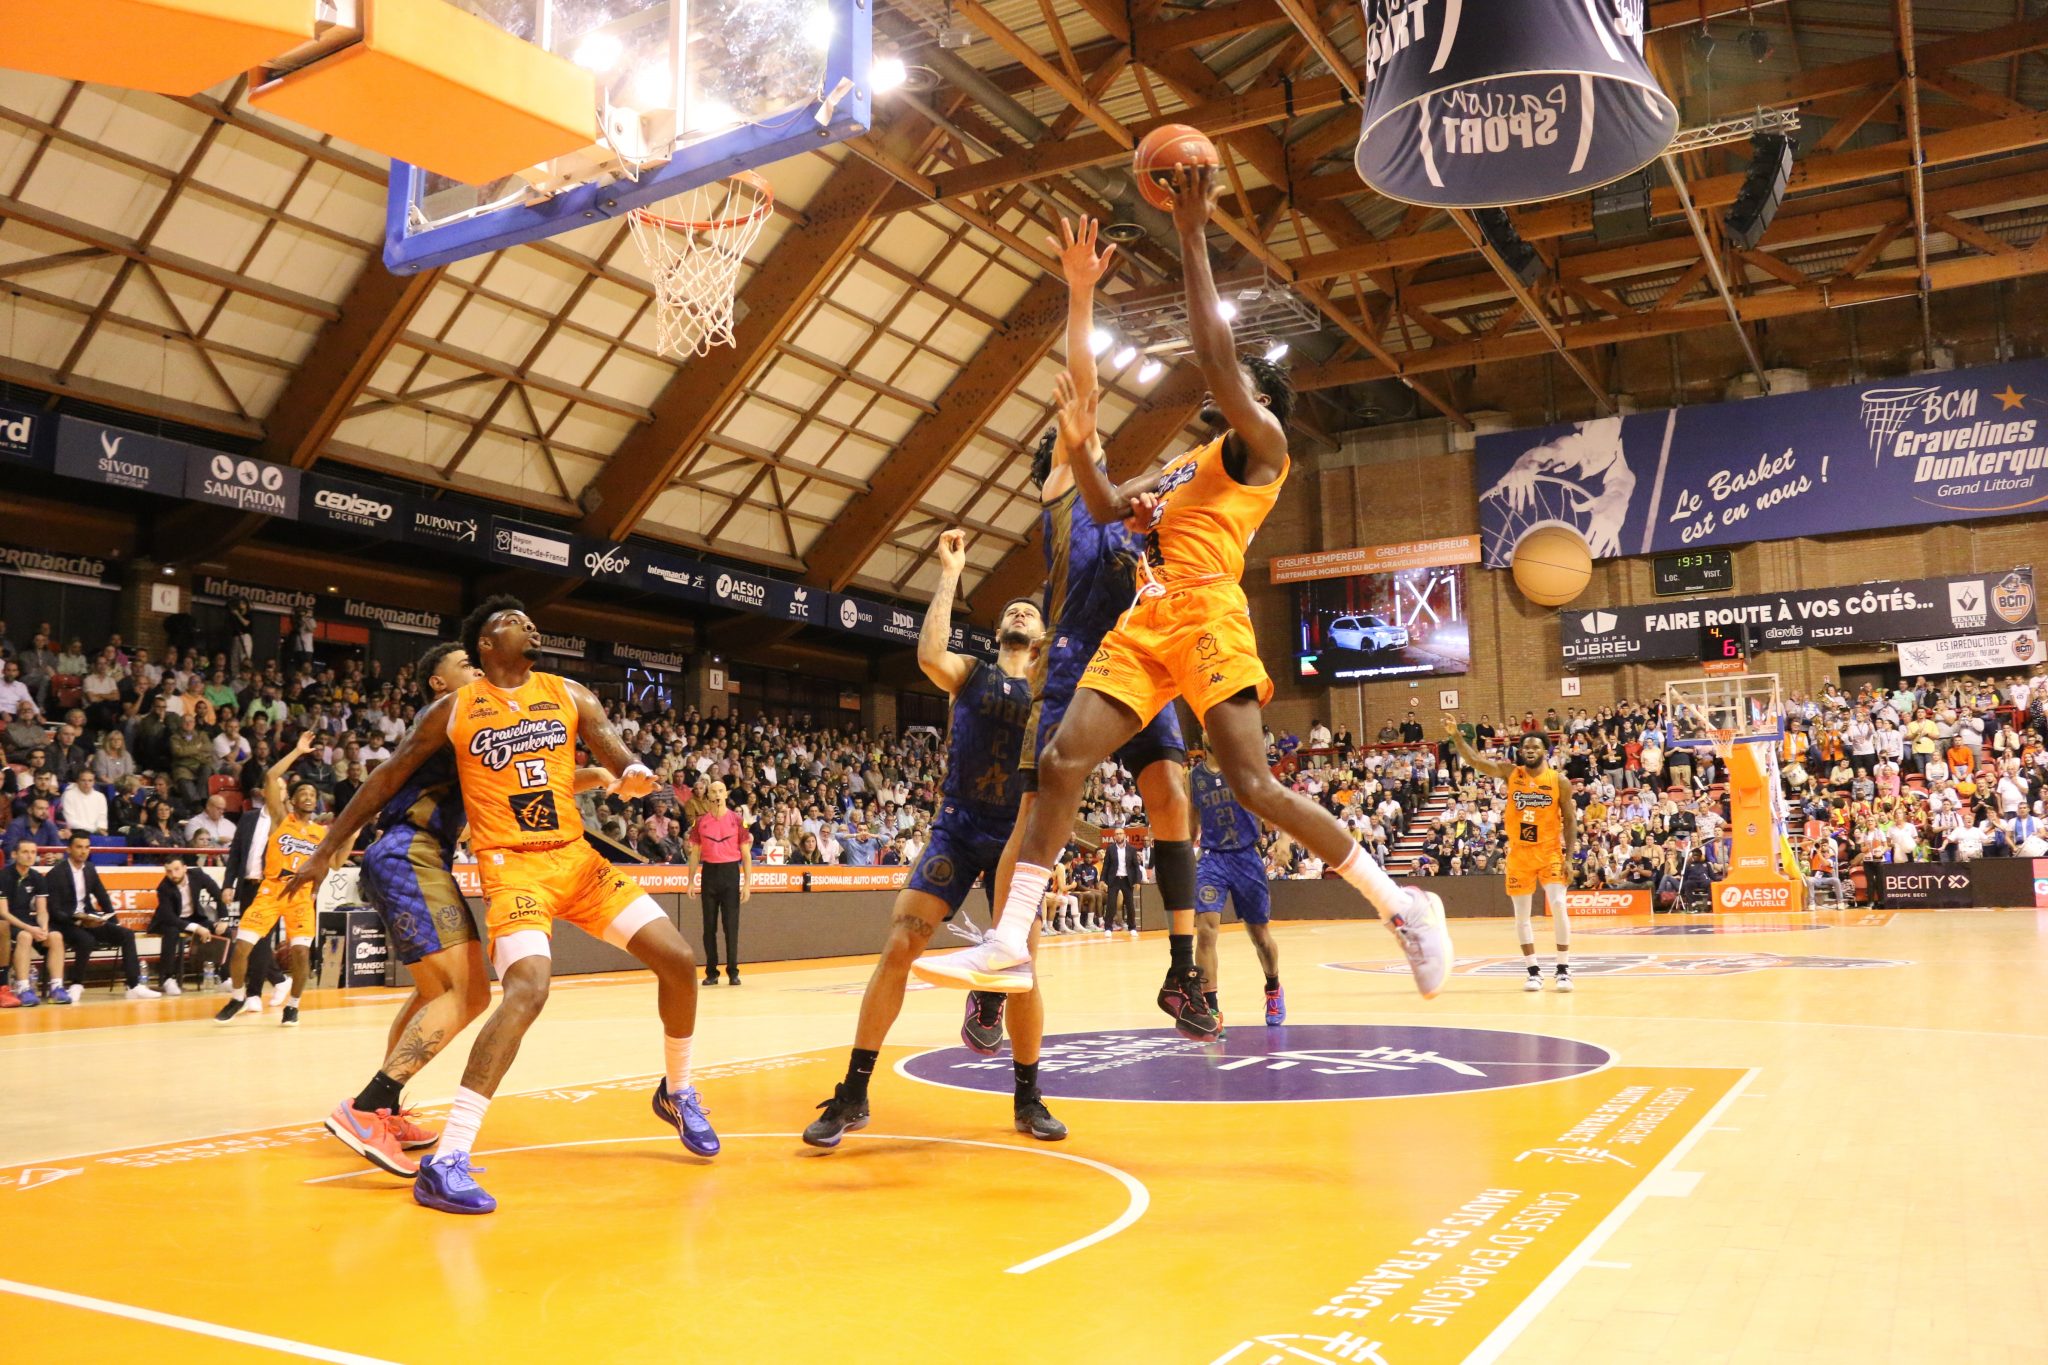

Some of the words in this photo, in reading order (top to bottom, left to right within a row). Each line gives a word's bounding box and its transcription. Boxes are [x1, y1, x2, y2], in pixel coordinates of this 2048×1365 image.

[1921, 388, 1979, 425] BCM
[1893, 419, 2037, 458] Gravelines
[1914, 446, 2048, 483] Dunkerqu
[204, 480, 285, 509] SANITATION
[1669, 489, 1703, 523] Le
[1707, 448, 1797, 501] Basket
[1937, 480, 1981, 497] Grand
[1984, 475, 2035, 492] Littoral
[1681, 511, 1716, 544] est
[1722, 503, 1750, 526] en
[1756, 475, 1812, 511] nous
[329, 511, 375, 527] LOCATION
[415, 513, 463, 532] DUPONT
[513, 546, 567, 563] Hauts-de-France
[1376, 545, 1411, 558] GROUPE
[1413, 539, 1470, 554] LEMPEREUR
[1276, 556, 1311, 569] GROUPE
[1312, 551, 1365, 566] LEMPEREUR
[1676, 554, 1712, 567] 19:37
[1276, 570, 1317, 580] PARTENAIRE
[1352, 564, 1363, 574] DU
[1363, 562, 1380, 573] BCM
[732, 581, 765, 599] AÉSIO
[731, 593, 763, 607] MUTUELLE
[1999, 594, 2027, 608] BCM
[789, 603, 809, 616] STC
[858, 612, 873, 623] NORD
[1645, 611, 1701, 633] FAIRE
[1705, 605, 1773, 627] ROUTE
[1777, 597, 1793, 621] À
[1797, 599, 1840, 619] VOS
[1765, 625, 1803, 639] clovis
[1811, 626, 1853, 638] ISUZU
[1954, 621, 1986, 629] TRUCKS
[541, 634, 586, 651] marché
[1562, 640, 1641, 657] DUBREU
[1575, 635, 1626, 644] GROUPE
[1723, 639, 1736, 657] 6
[1936, 642, 1949, 652] LES
[1950, 635, 2008, 650] IRREDUCTIBLES
[613, 642, 684, 666] Intermarché
[713, 673, 720, 685] E
[1087, 666, 1110, 677] ovis
[1568, 682, 1576, 691] H
[470, 720, 547, 755] Gravelines
[482, 732, 567, 770] Dunkerque
[514, 759, 548, 788] 13
[1216, 806, 1235, 826] 23
[1522, 810, 1535, 822] 25
[639, 875, 662, 886] AUTO
[663, 875, 688, 886] MOTO
[739, 872, 787, 885] EPEREUR
[790, 875, 852, 886] COESSIONNAIRE
[853, 875, 870, 885] AUTO
[871, 875, 890, 885] MOTO
[1885, 875, 1945, 890] BECITY
[1742, 900, 1786, 908] MUTUELLE
[353, 962, 385, 970] TRANSDE
[1556, 1114, 1620, 1143] FRANCE
[1441, 1188, 1523, 1227] HAUTS
[1501, 1191, 1581, 1233] CAISSE
[1411, 1228, 1473, 1248] DE
[1312, 1250, 1443, 1320] FRANCE
